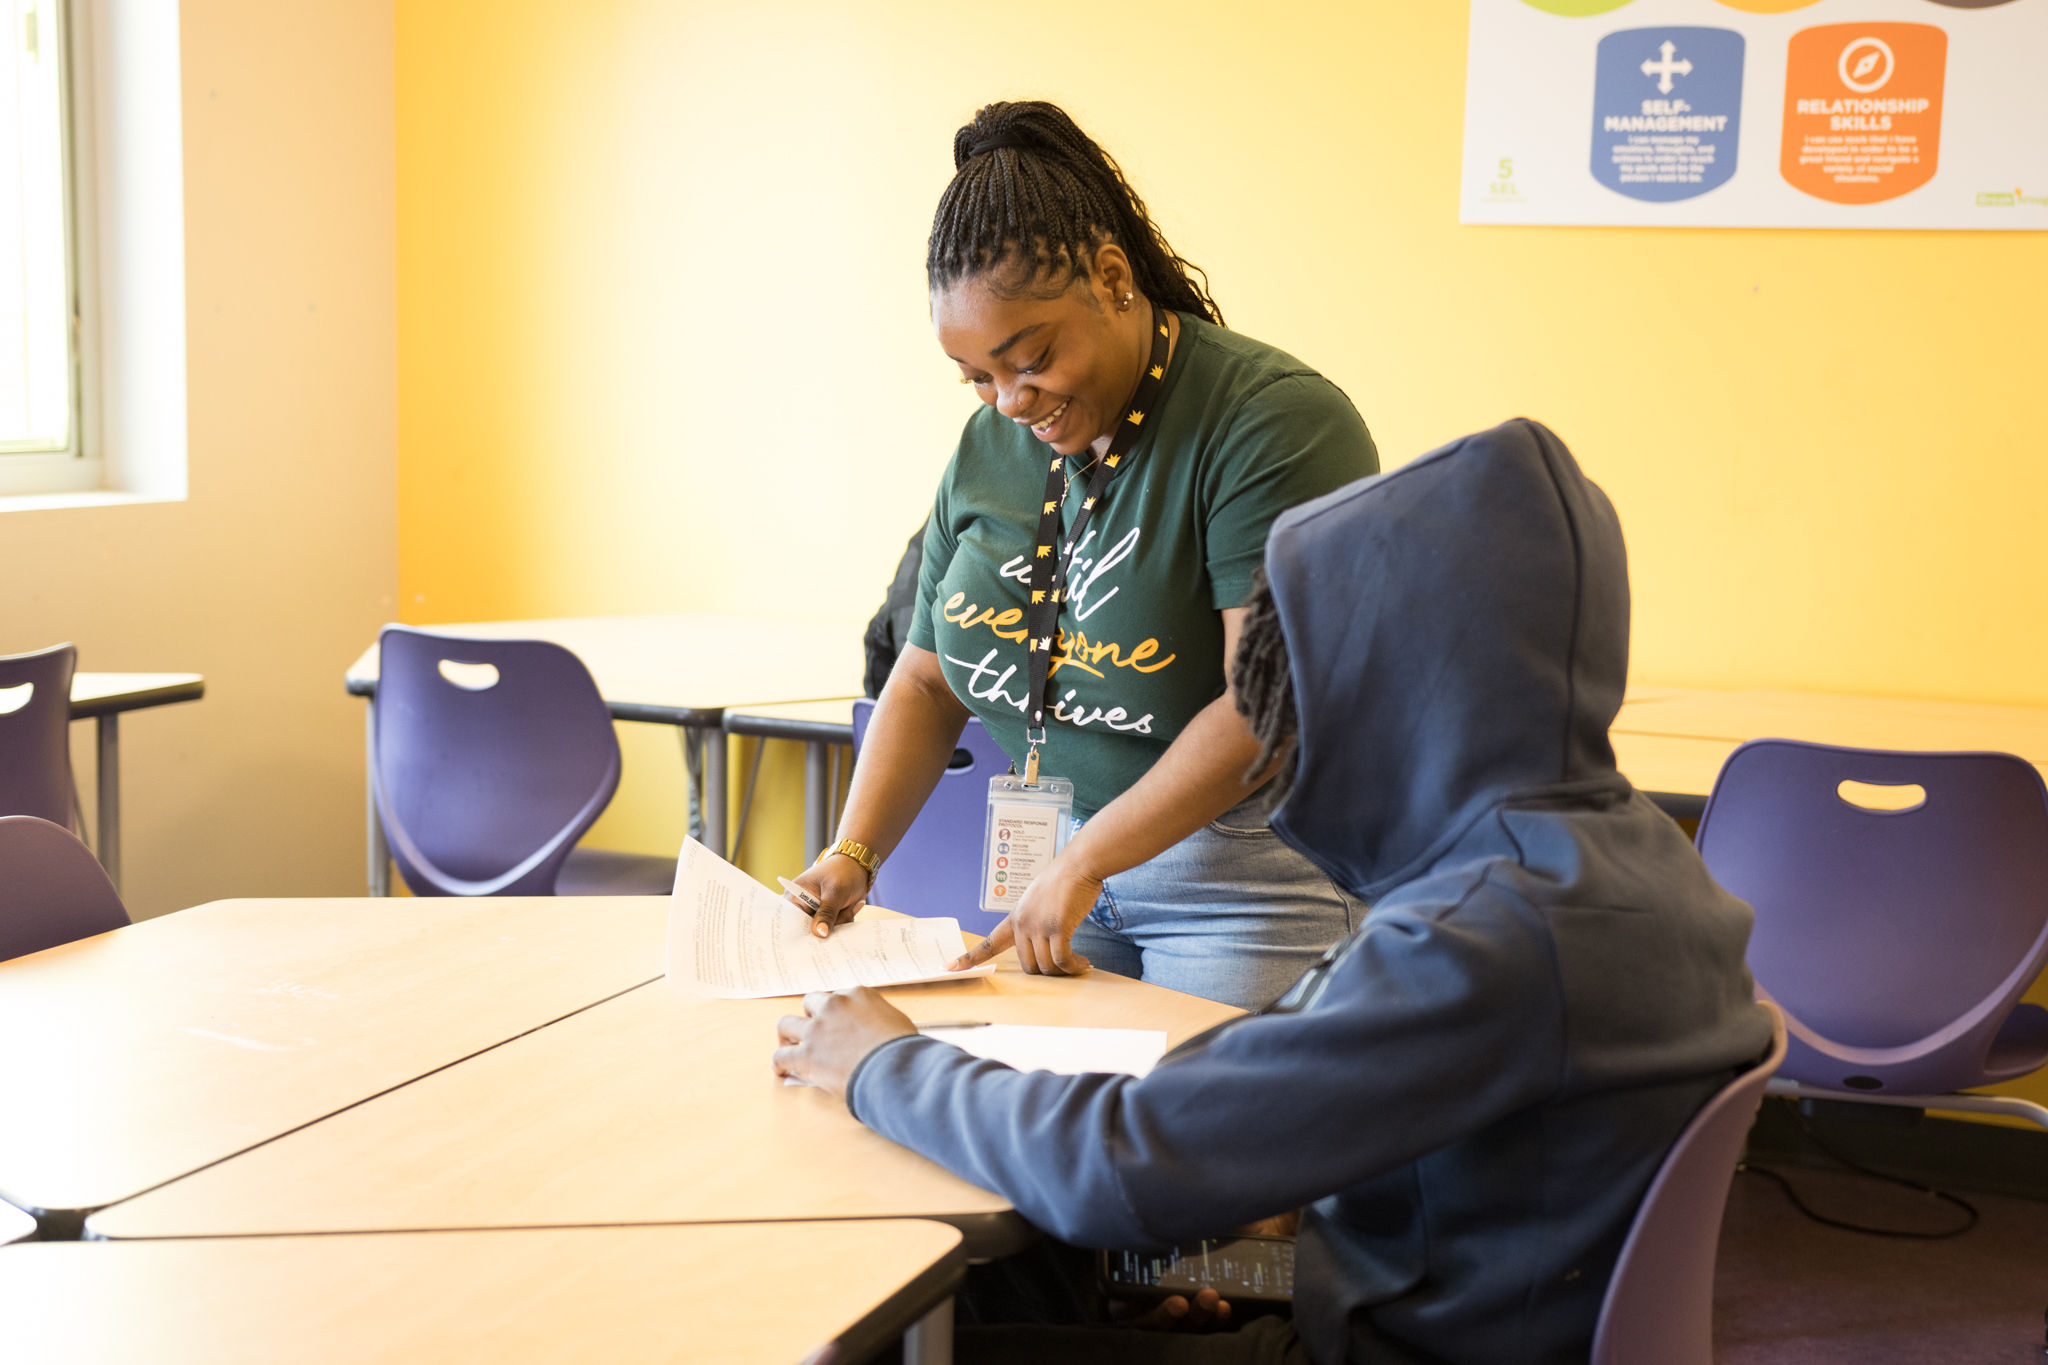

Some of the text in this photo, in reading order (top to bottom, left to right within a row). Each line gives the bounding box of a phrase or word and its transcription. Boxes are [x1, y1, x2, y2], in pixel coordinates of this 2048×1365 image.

[1642, 99, 1691, 116] SELF-
[1797, 98, 1929, 115] RELATIONSHIP
[1604, 115, 1728, 132] MANAGEMENT
[1830, 115, 1892, 131] SKILLS
[1498, 158, 1513, 179] 5
[1489, 181, 1520, 195] SEL
[1000, 527, 1140, 621] util
